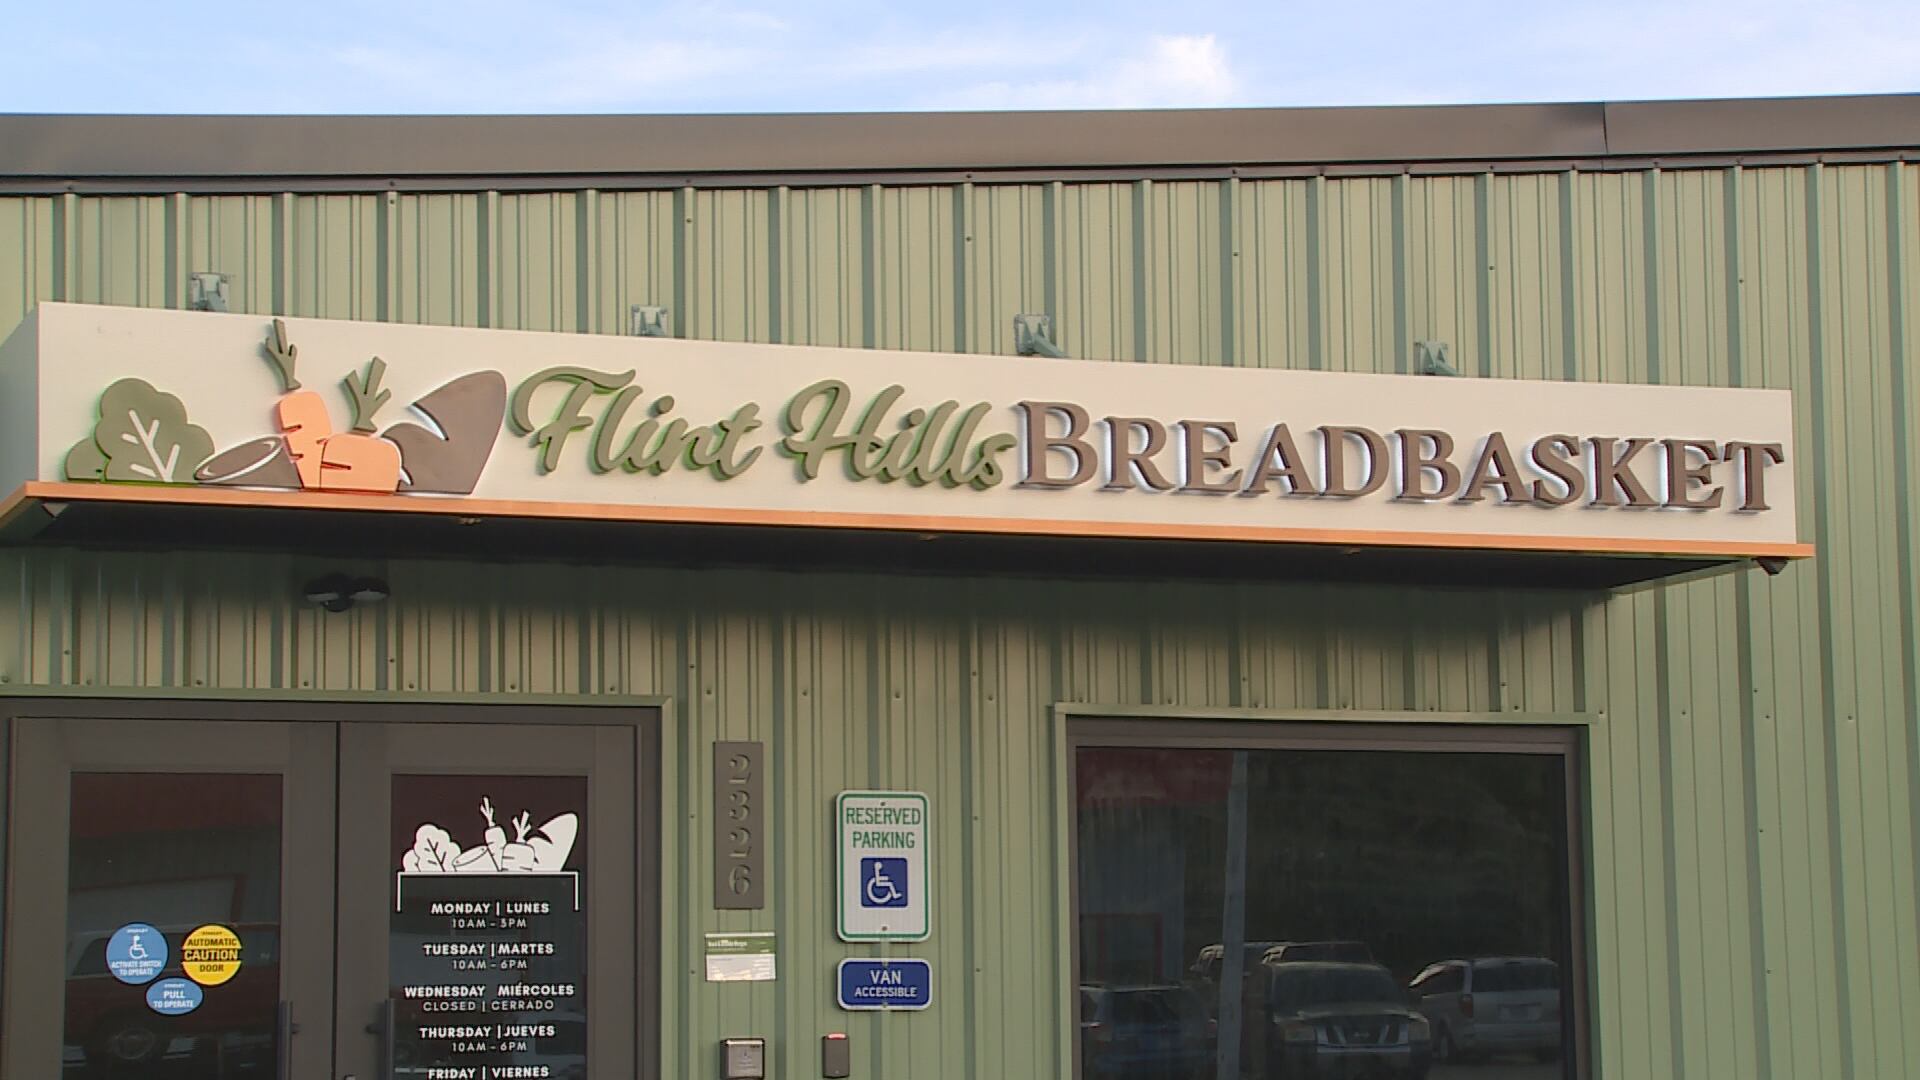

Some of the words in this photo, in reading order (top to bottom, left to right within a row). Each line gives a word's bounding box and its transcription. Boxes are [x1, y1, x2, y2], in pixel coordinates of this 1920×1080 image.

[510, 366, 763, 480] Flint
[779, 379, 1017, 490] Hills
[1017, 399, 1785, 511] BREADBASKET
[846, 807, 921, 825] RESERVED
[728, 754, 751, 895] 2326
[852, 831, 915, 849] PARKING
[431, 903, 490, 914] MONDAY
[506, 903, 550, 913] LUNES
[453, 918, 486, 928] 10AM
[187, 938, 237, 946] AUTOMATIC
[424, 944, 485, 955] TUESDAY
[498, 943, 554, 954] MARTES
[184, 949, 238, 961] CAUTION
[199, 964, 224, 972] DOOR
[453, 960, 487, 969] 10AM
[501, 960, 527, 969] 6PM
[120, 968, 128, 976] TO
[869, 969, 901, 985] VAN
[163, 990, 186, 999] PULL
[404, 985, 486, 997] WEDNESDAY
[498, 982, 574, 996] MIÉRCOLES
[854, 986, 917, 997] ACCESSIBLE
[153, 1000, 162, 1008] TO
[164, 1000, 193, 1009] OPERATE
[423, 1001, 476, 1011] CLOSED
[491, 1000, 554, 1011] CERRADO
[419, 1026, 491, 1038] THURSDAY
[504, 1025, 556, 1037] JUEVES
[452, 1042, 486, 1052] 10AM
[501, 1042, 527, 1051] 6PM
[428, 1068, 475, 1080] FRIDAY
[492, 1066, 550, 1078] VIERNES
